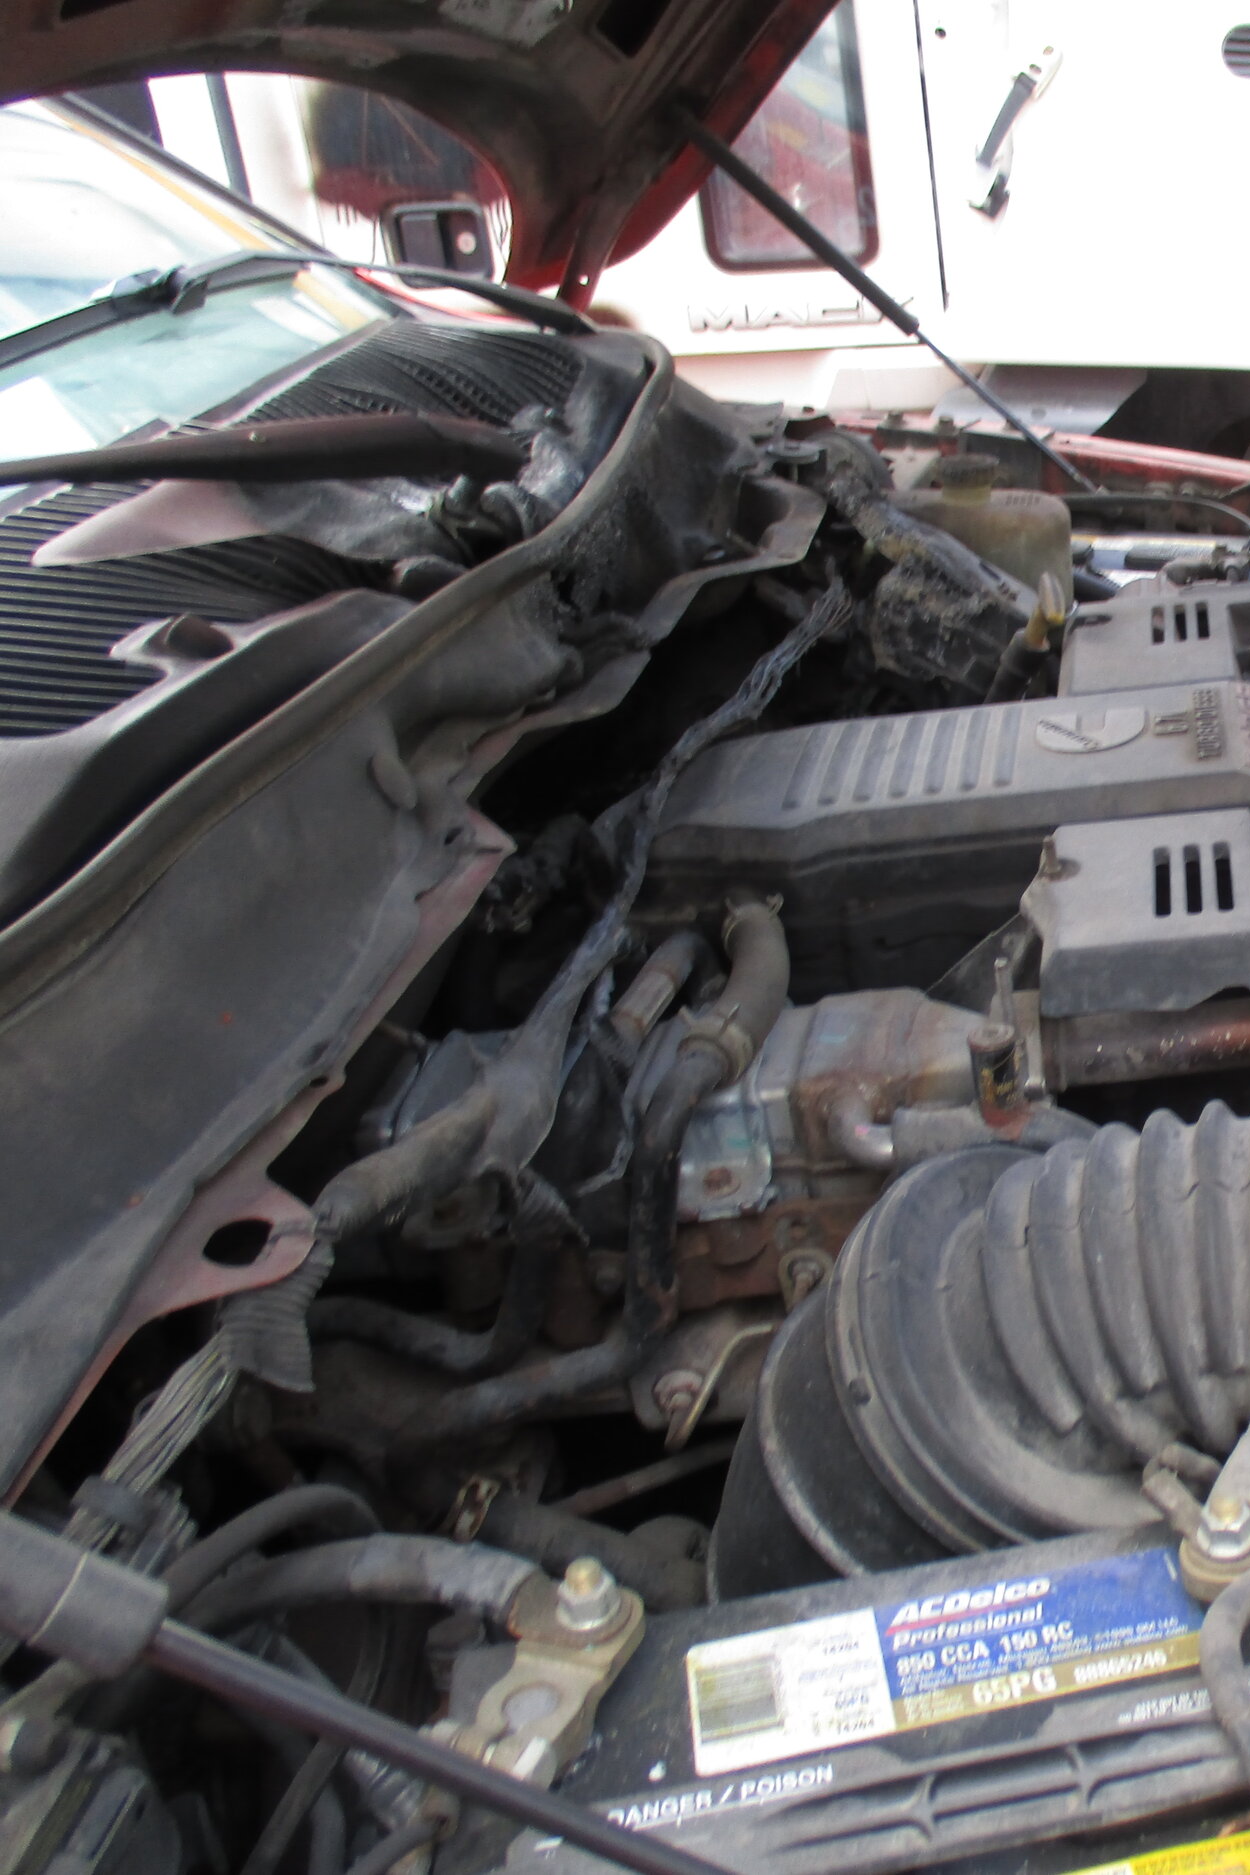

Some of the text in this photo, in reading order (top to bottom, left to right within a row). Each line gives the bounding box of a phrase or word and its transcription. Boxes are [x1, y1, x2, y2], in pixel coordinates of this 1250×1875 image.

[890, 1577, 1050, 1627] ACDelco
[893, 1602, 1043, 1649] Professional
[941, 1641, 990, 1666] CCA
[1042, 1620, 1074, 1645] RC
[972, 1666, 1057, 1706] 65PG
[719, 1783, 736, 1805] /
[740, 1764, 834, 1799] POISON
